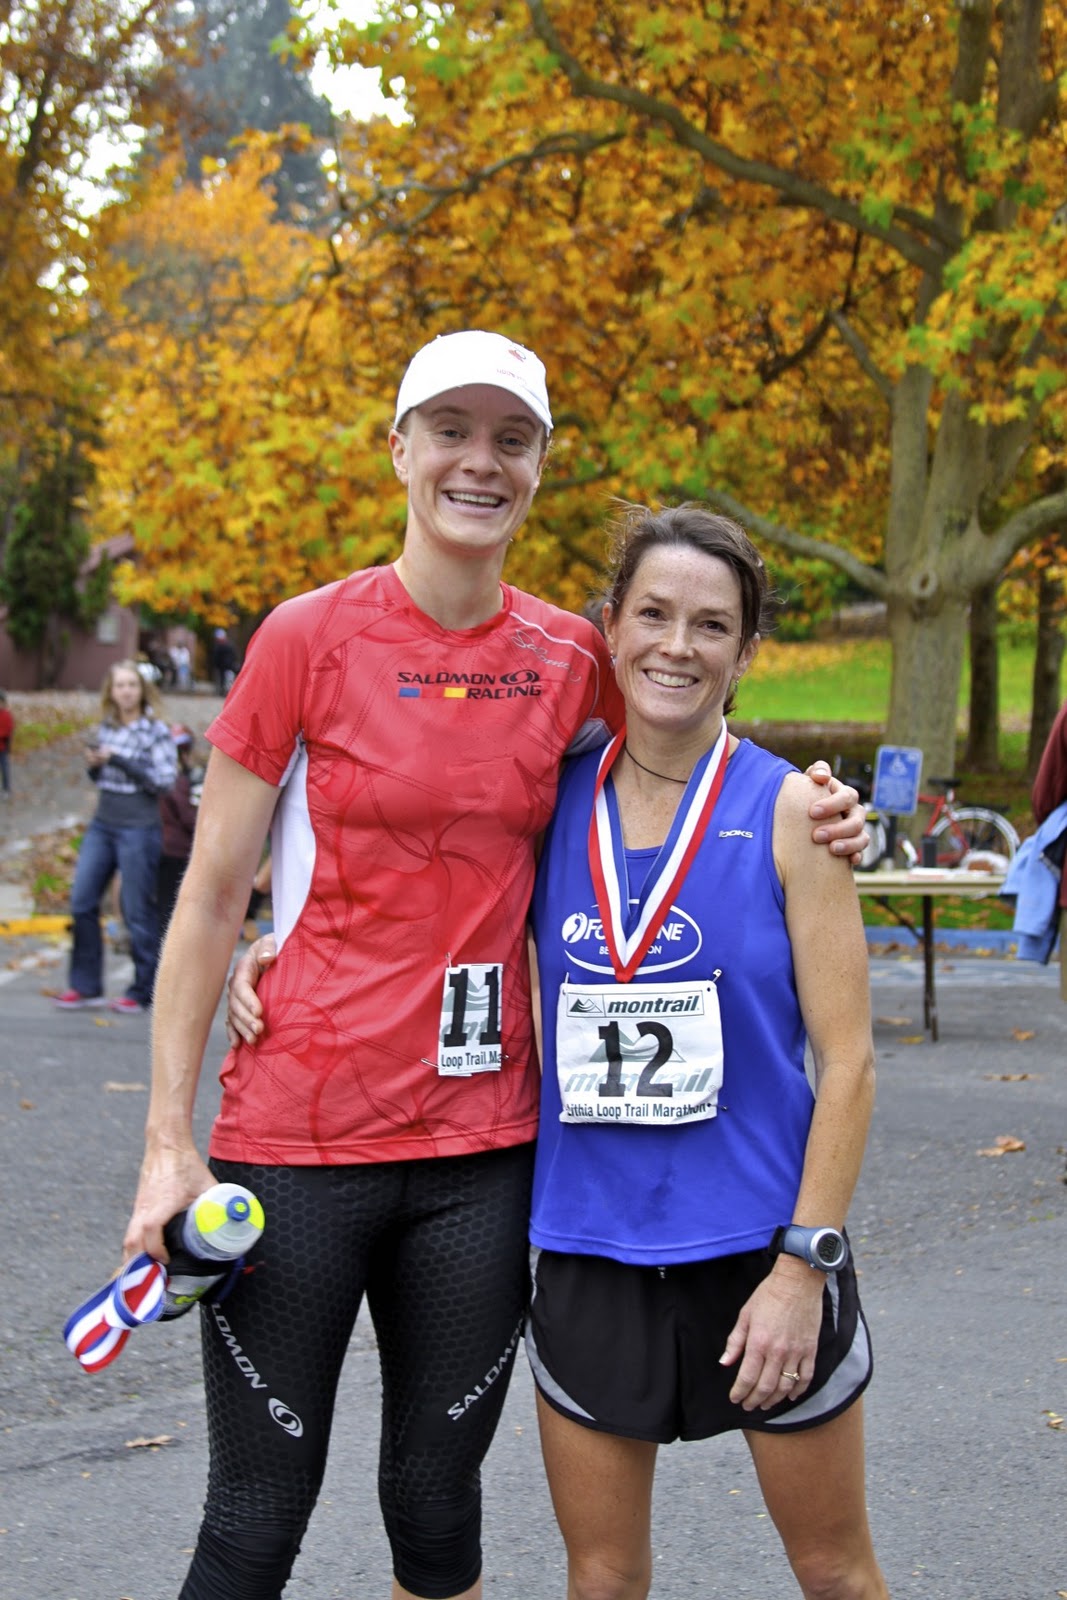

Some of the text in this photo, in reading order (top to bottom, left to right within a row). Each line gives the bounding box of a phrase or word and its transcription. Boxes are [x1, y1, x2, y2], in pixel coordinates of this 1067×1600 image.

[397, 671, 496, 685] SALOMON
[466, 684, 542, 699] RACING
[443, 966, 502, 1048] 11
[607, 995, 700, 1014] montrail
[441, 1054, 463, 1070] Loop
[465, 1052, 487, 1066] Trail
[598, 1021, 674, 1097] 12
[597, 1103, 622, 1120] Loop
[624, 1103, 649, 1117] Trail
[653, 1102, 707, 1118] Marathon
[211, 1302, 268, 1389] LOMON
